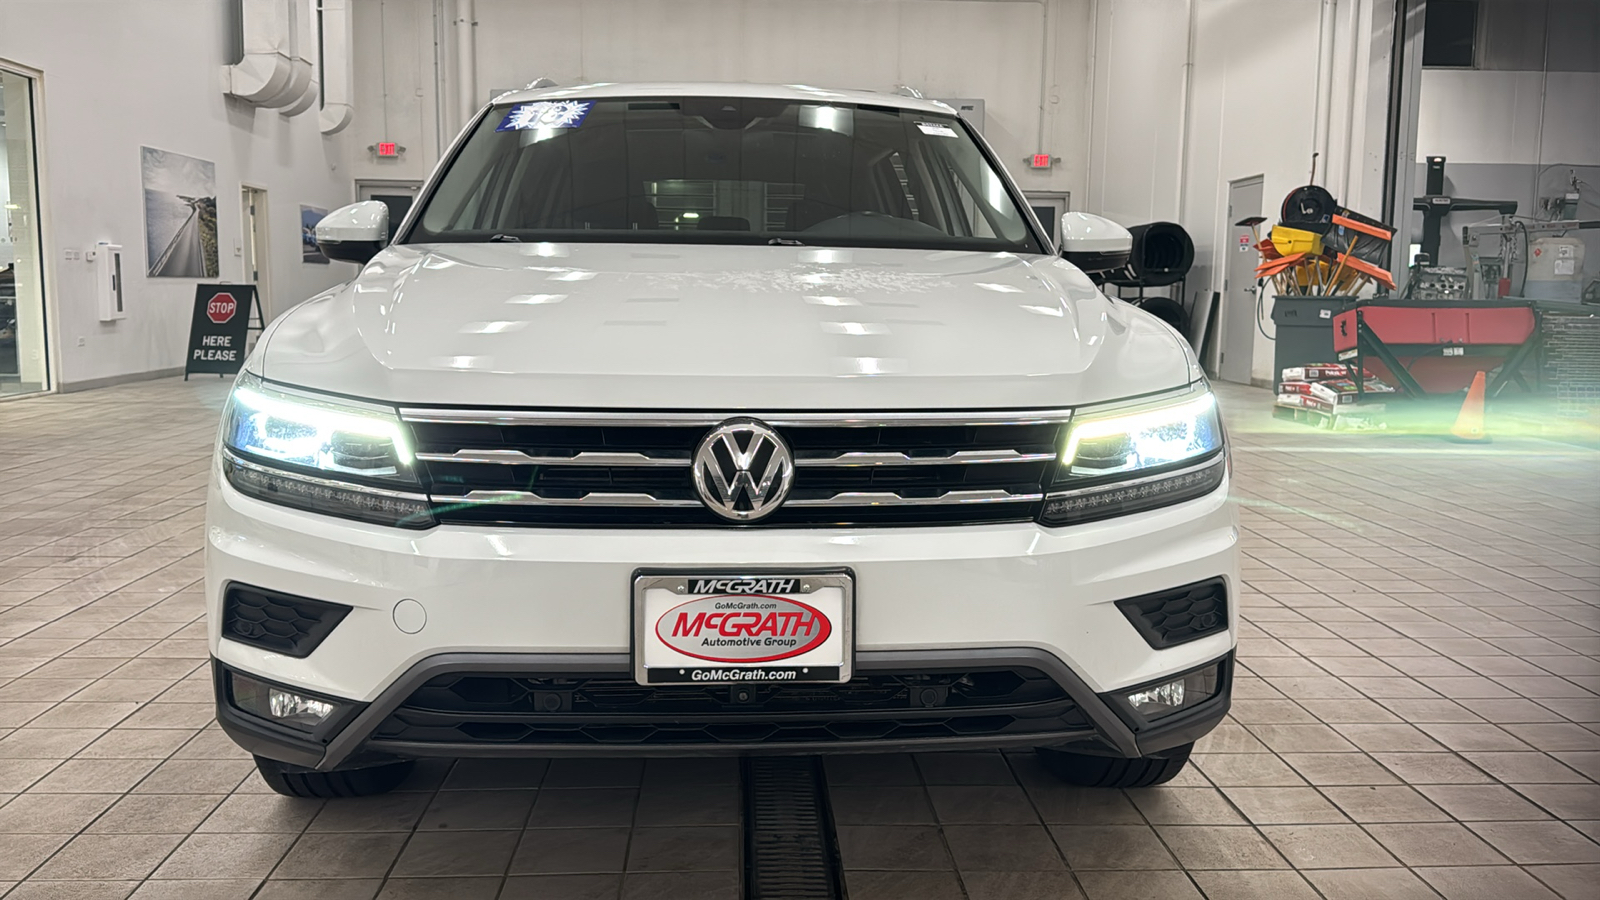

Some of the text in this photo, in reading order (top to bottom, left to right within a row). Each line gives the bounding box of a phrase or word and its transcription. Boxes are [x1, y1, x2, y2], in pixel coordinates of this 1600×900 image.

[209, 302, 234, 314] STOP
[202, 335, 232, 347] HERE
[193, 349, 237, 361] PLEASE
[714, 602, 777, 610] GoMcGrath.com
[701, 637, 797, 648] Automotive Group
[691, 669, 797, 681] GoMcGrath.com
